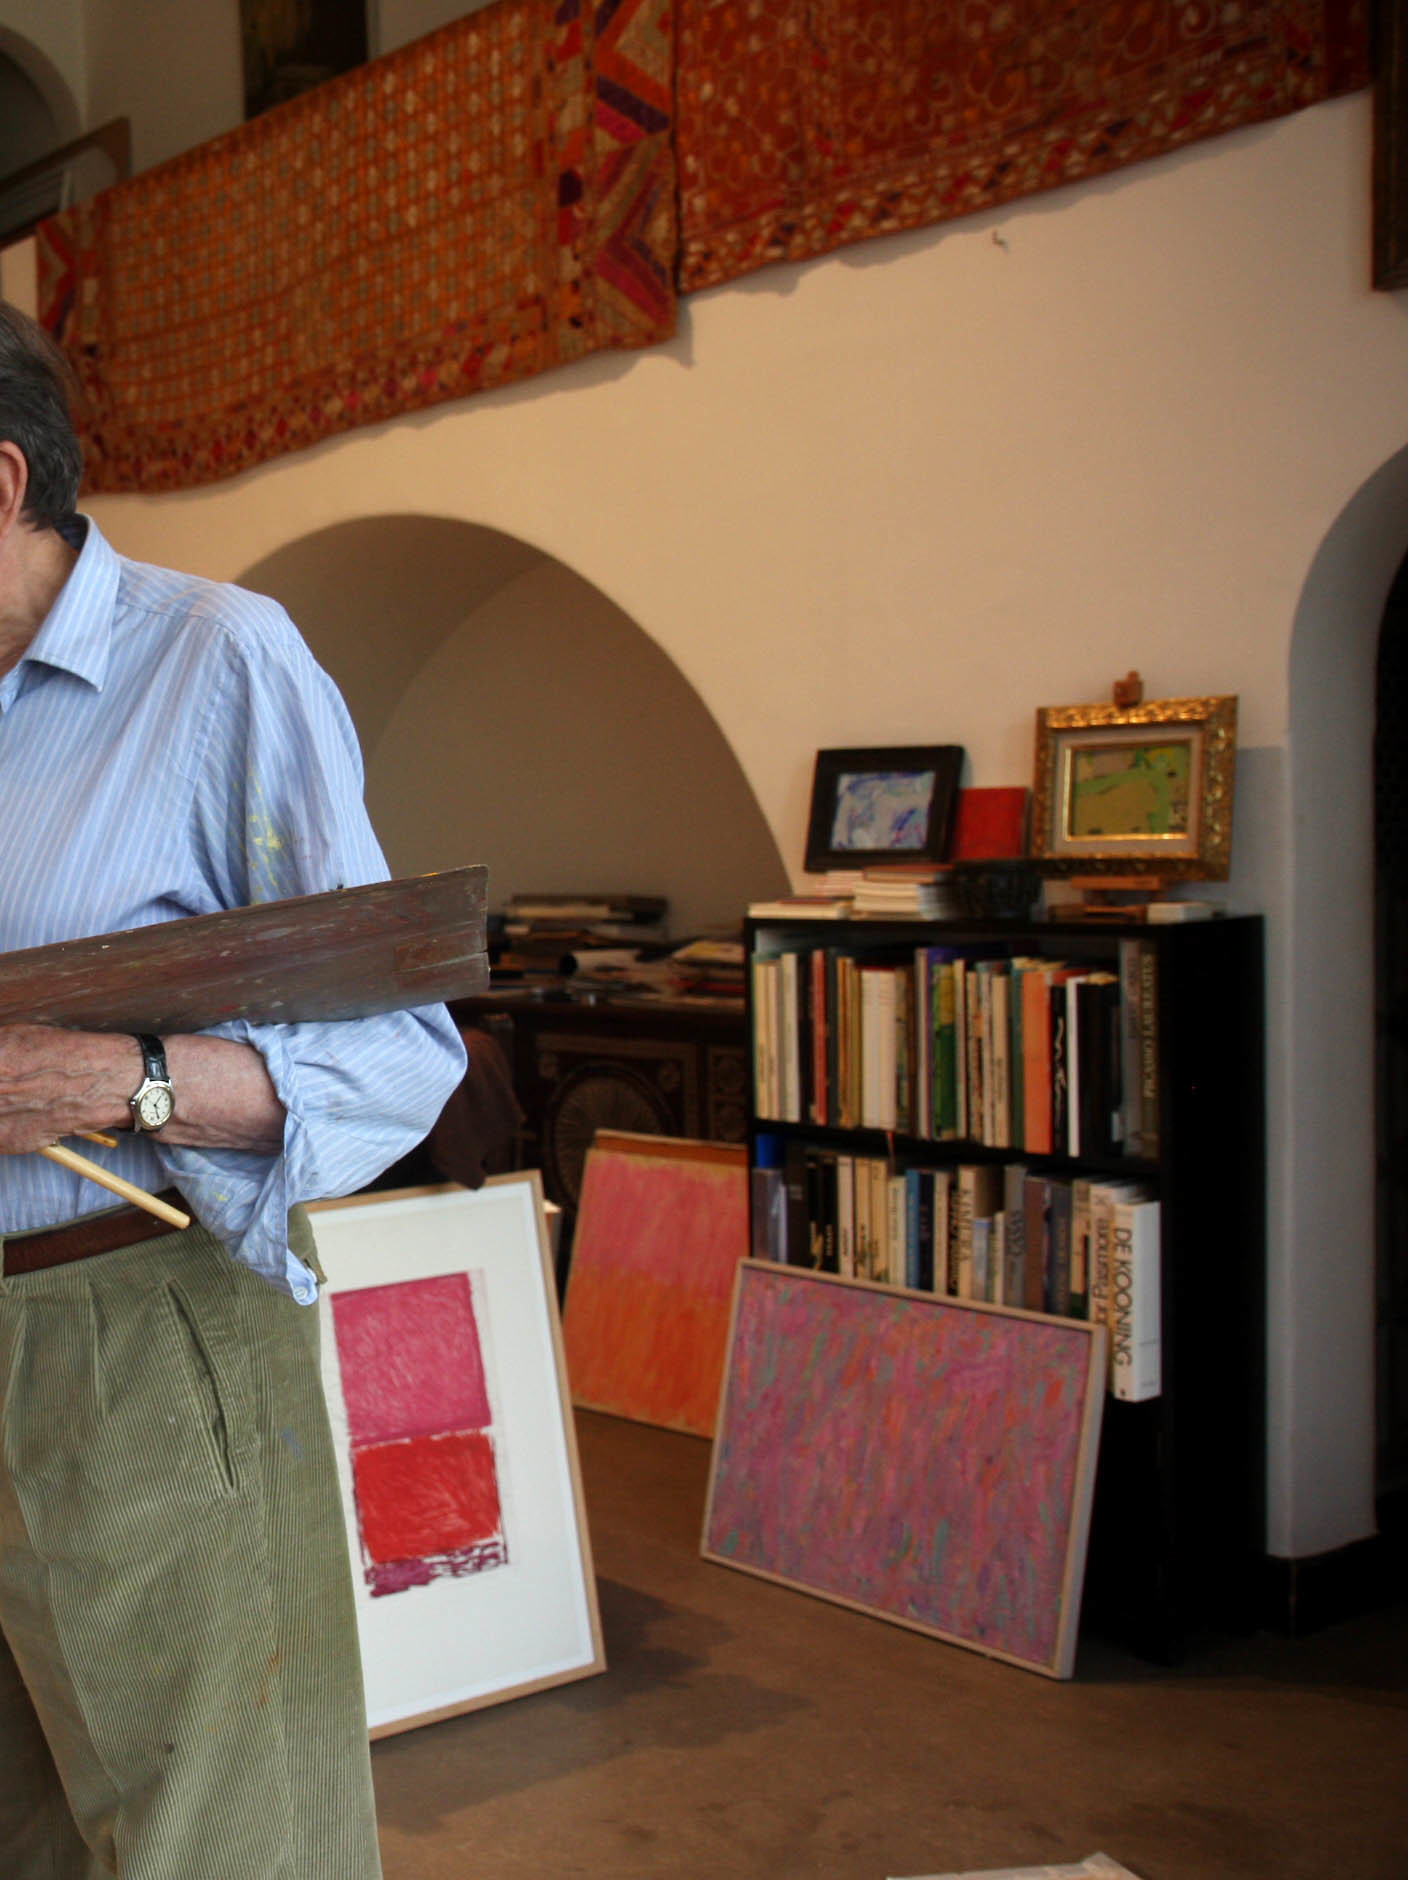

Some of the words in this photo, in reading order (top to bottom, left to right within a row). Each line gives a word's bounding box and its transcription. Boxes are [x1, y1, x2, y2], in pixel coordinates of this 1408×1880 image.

[1093, 1217, 1109, 1300] Pasmore
[1114, 1227, 1132, 1255] DE
[1114, 1259, 1132, 1367] KOONING
